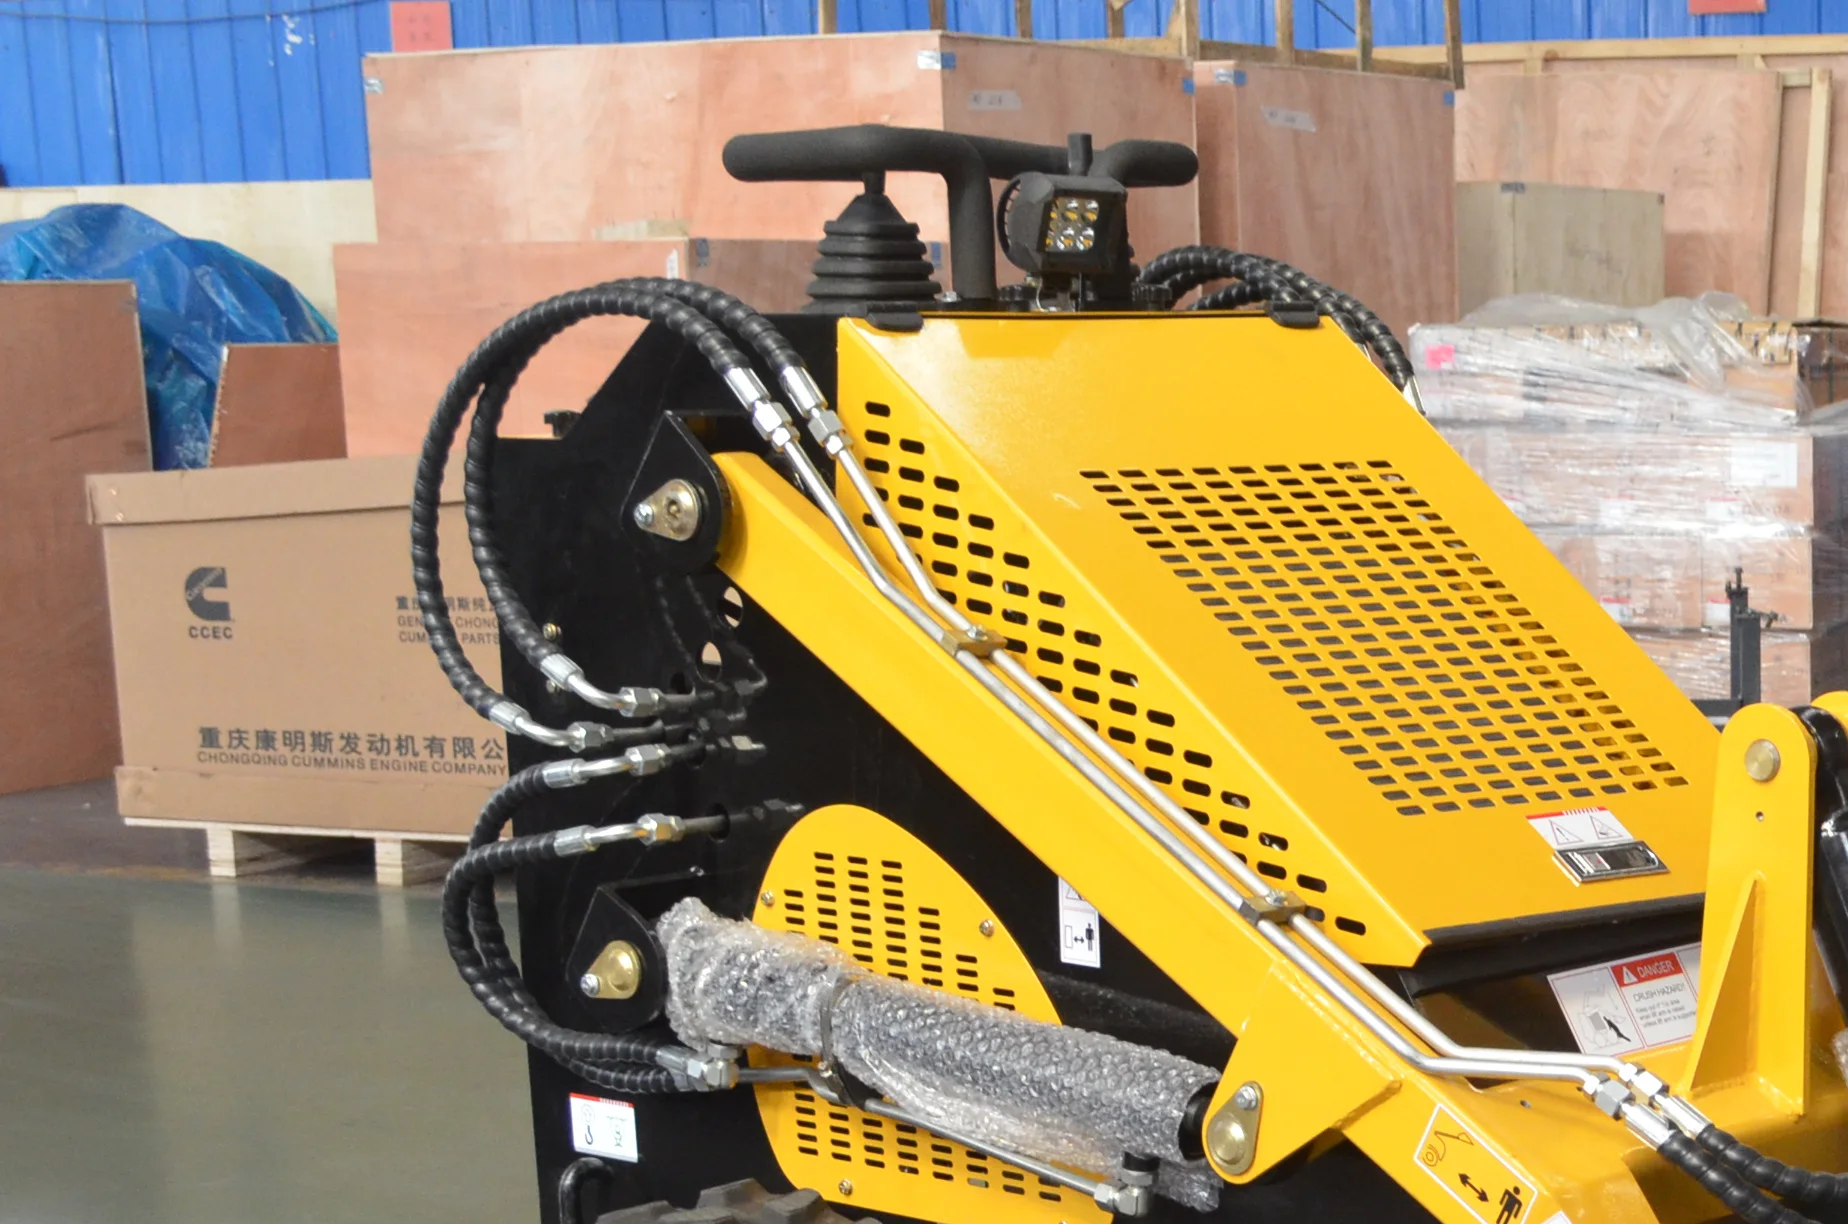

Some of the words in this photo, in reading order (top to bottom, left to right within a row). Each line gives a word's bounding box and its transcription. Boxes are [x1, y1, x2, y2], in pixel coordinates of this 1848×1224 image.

[188, 625, 233, 639] CCEC
[198, 727, 505, 761] 重庆康明斯发动机有限公
[197, 751, 288, 767] CHONGQING
[291, 754, 366, 770] CUMMINS
[370, 758, 428, 773] ENGINE
[431, 761, 507, 776] COMPANY
[1636, 960, 1675, 978] DANGER
[1632, 989, 1657, 1002] CRUSH
